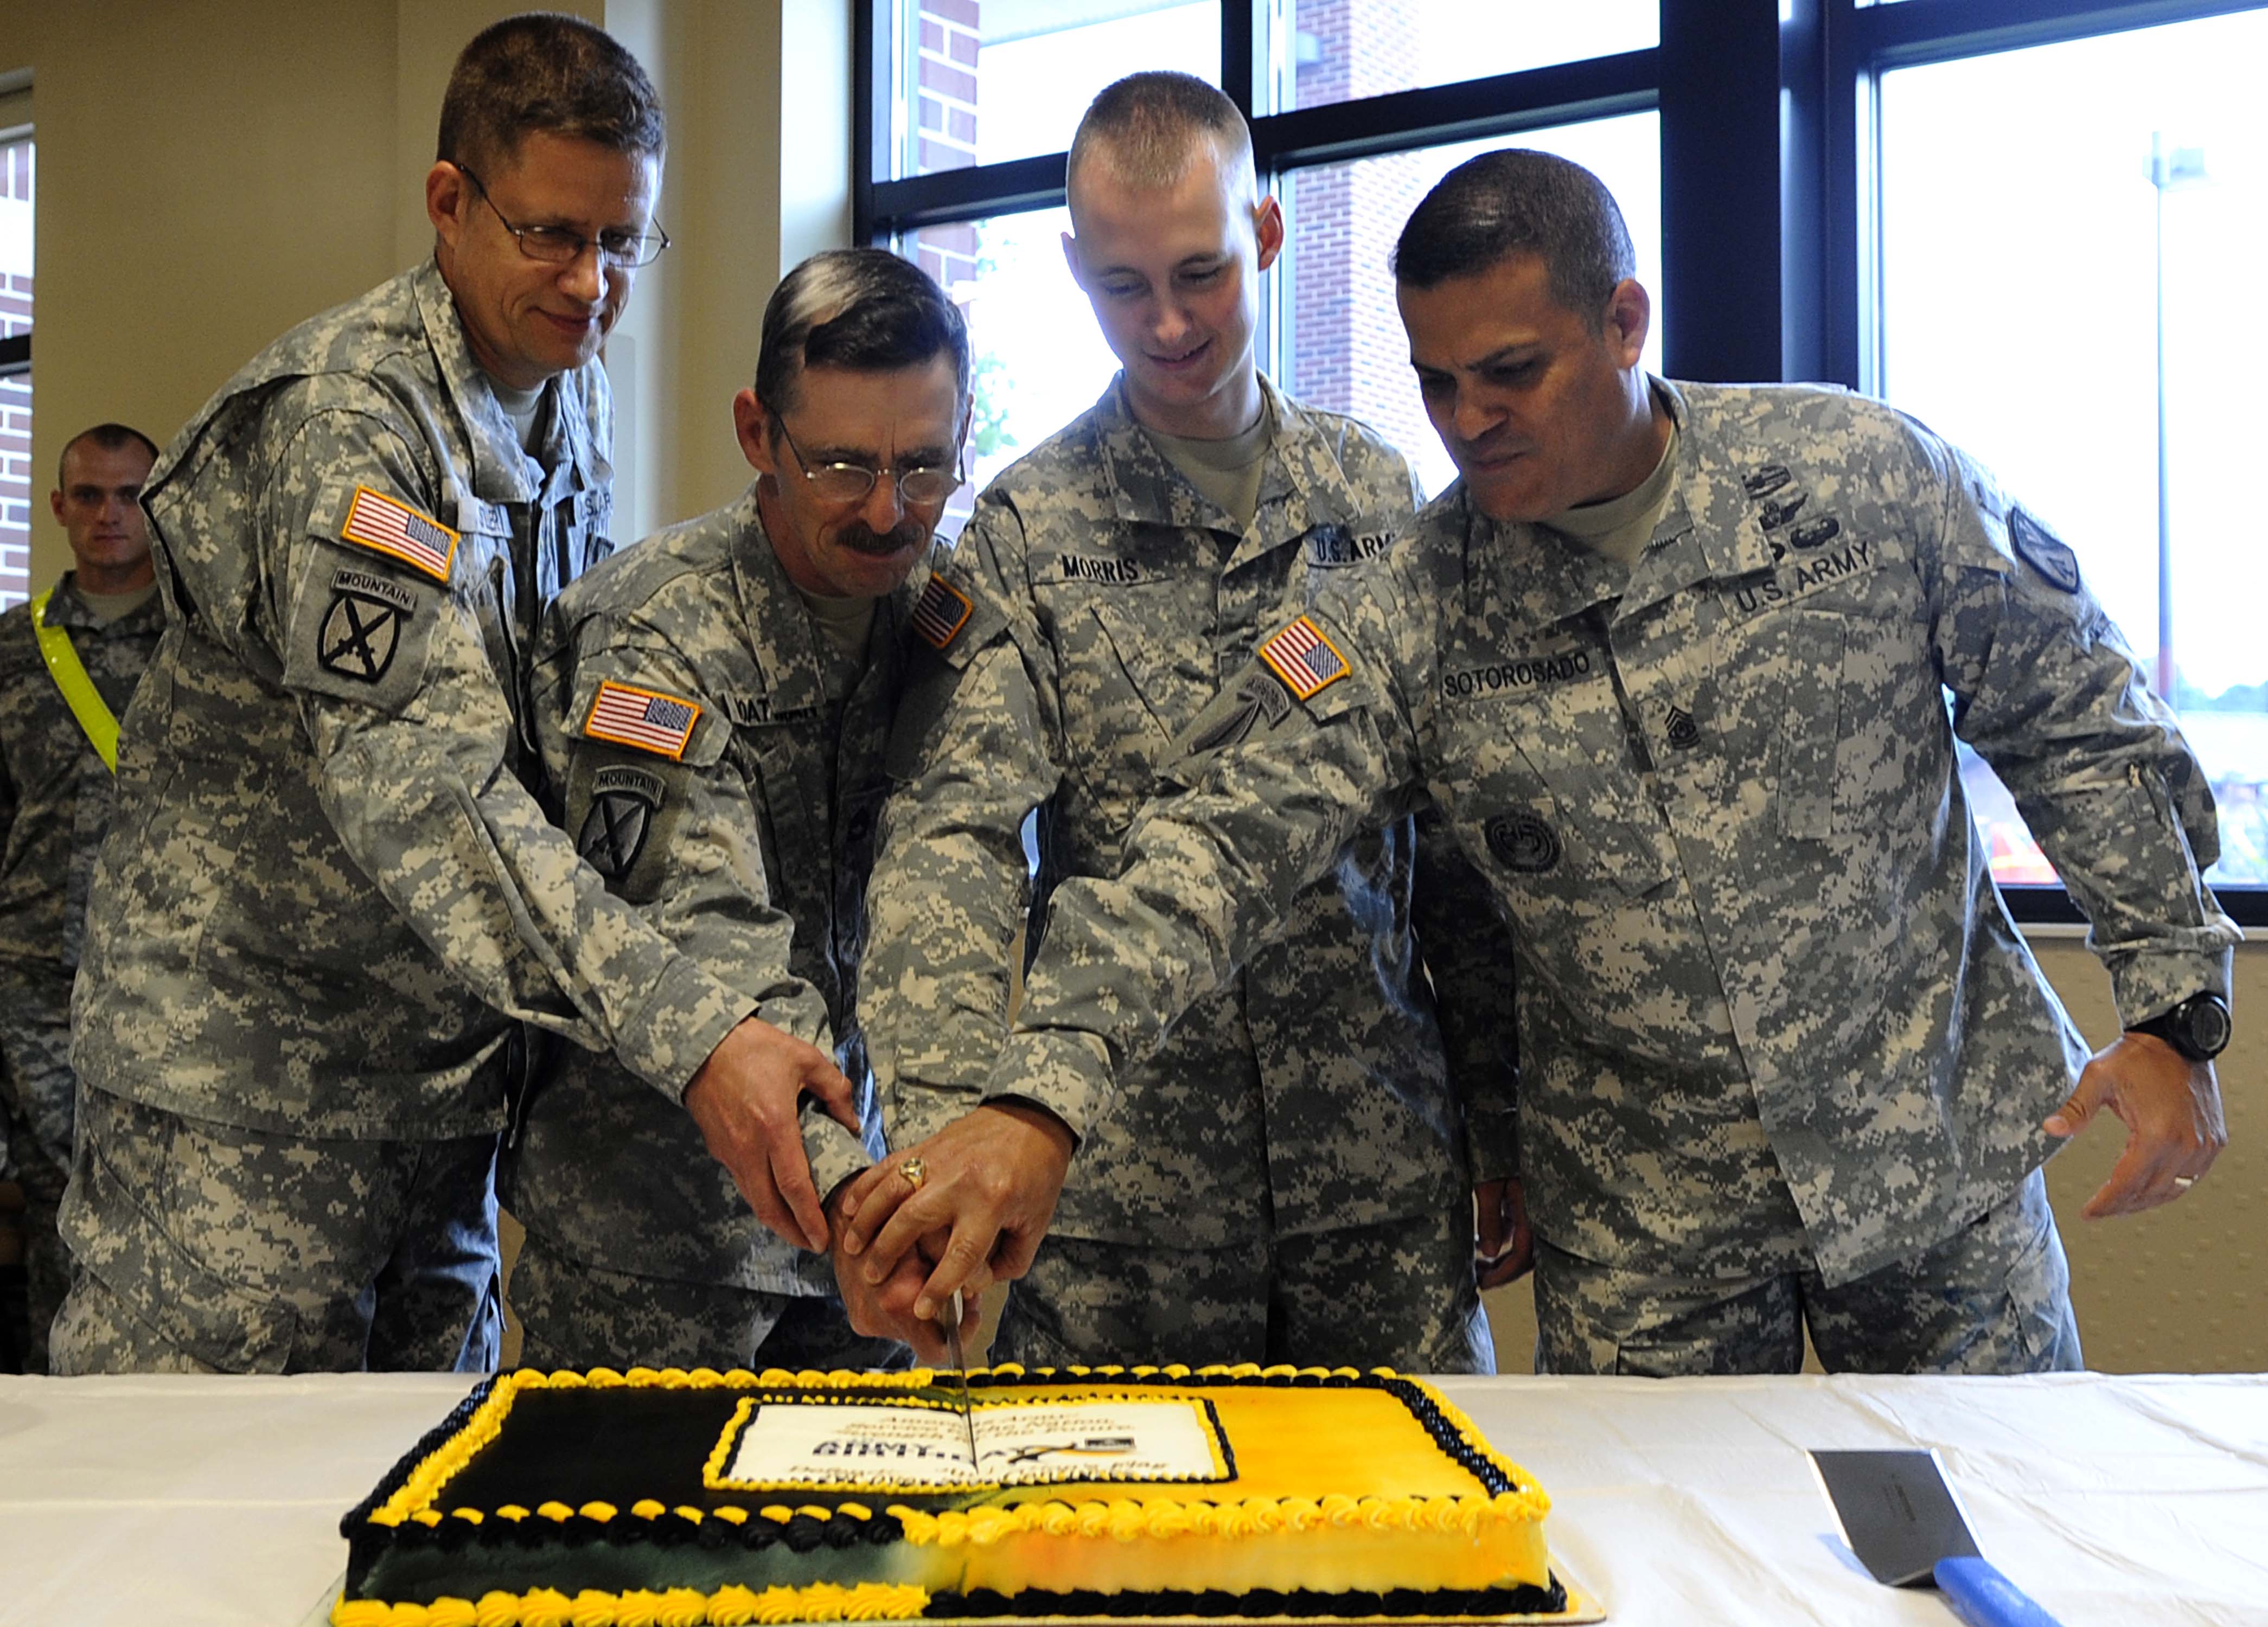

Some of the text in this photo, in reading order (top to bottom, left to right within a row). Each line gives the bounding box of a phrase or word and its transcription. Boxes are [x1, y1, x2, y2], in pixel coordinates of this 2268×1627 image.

[1350, 532, 1396, 562] ARM
[1062, 554, 1139, 582] MORRIS
[1735, 540, 1869, 612] U.S. ARMY
[338, 571, 411, 606] MOUNTAIN
[1443, 652, 1590, 697] SOTOROSADO
[598, 772, 659, 795] MOUNTAIN
